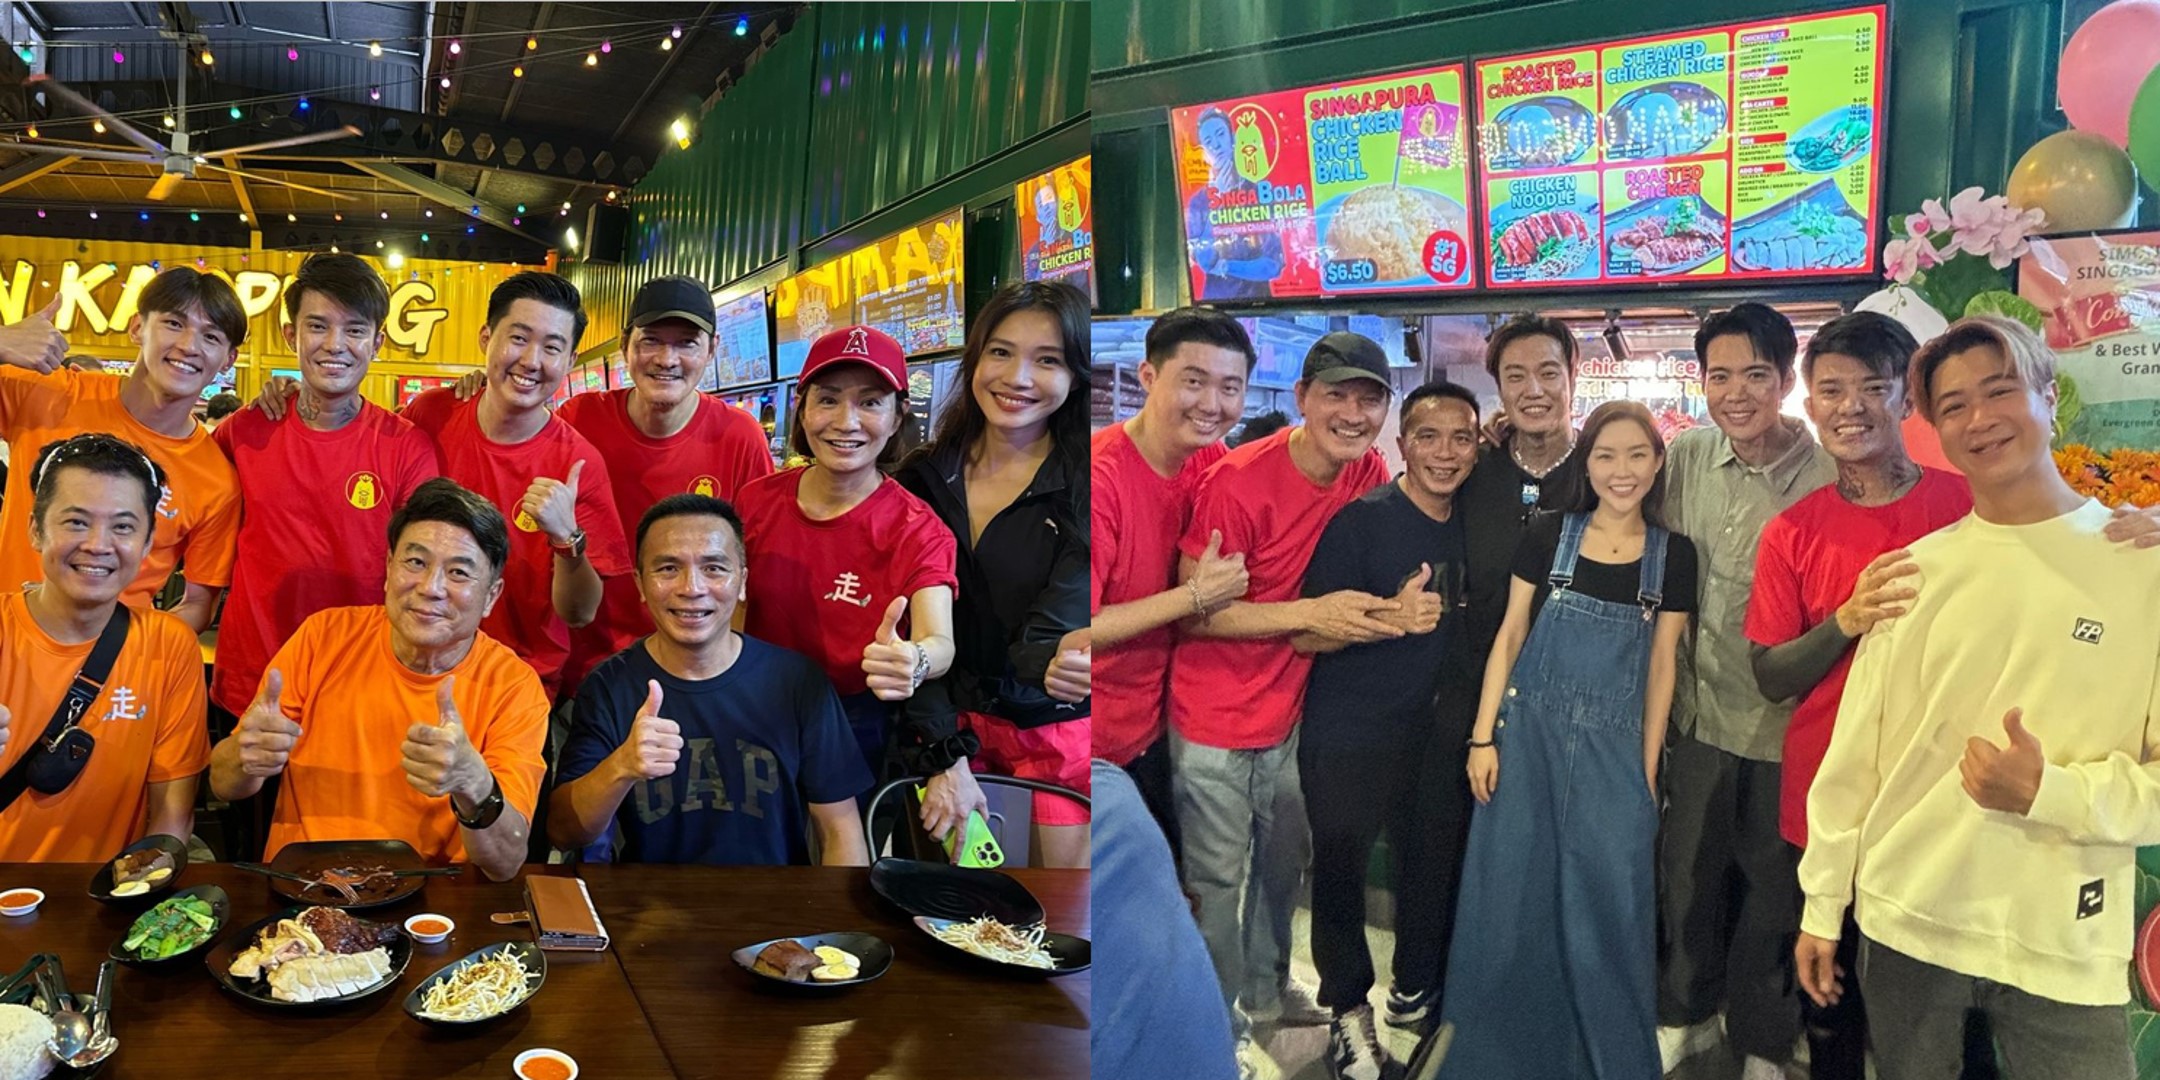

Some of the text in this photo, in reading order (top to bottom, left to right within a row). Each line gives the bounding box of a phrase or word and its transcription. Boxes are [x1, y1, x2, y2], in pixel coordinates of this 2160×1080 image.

[1623, 41, 1706, 67] STEAMED
[1502, 59, 1576, 81] ROASTED
[1605, 54, 1724, 84] CHICKEN RICE
[1487, 73, 1594, 99] CHICKEN RICE
[1310, 83, 1437, 119] SINGAPURA
[1312, 110, 1402, 141] CHICKEN
[1314, 138, 1359, 161] RICE
[1315, 160, 1367, 184] BALL
[1625, 165, 1704, 186] ROASTED
[1510, 176, 1577, 195] CHICKEN
[1627, 180, 1701, 199] CHICKEN
[1511, 190, 1577, 209] NOODLE
[1209, 205, 1270, 225] CHICKEN
[1273, 202, 1307, 219] RICE
[1434, 237, 1458, 258] #1
[1040, 249, 1082, 271] CHICKEN
[1431, 257, 1457, 276] SG
[1328, 261, 1374, 282] $6.50
[842, 326, 869, 356] A
[2095, 344, 2106, 357] &
[2113, 343, 2147, 356] Best
[2122, 361, 2160, 375] Gran
[2103, 418, 2154, 429] Evergreen
[824, 571, 872, 608] 走
[102, 686, 147, 722] 走
